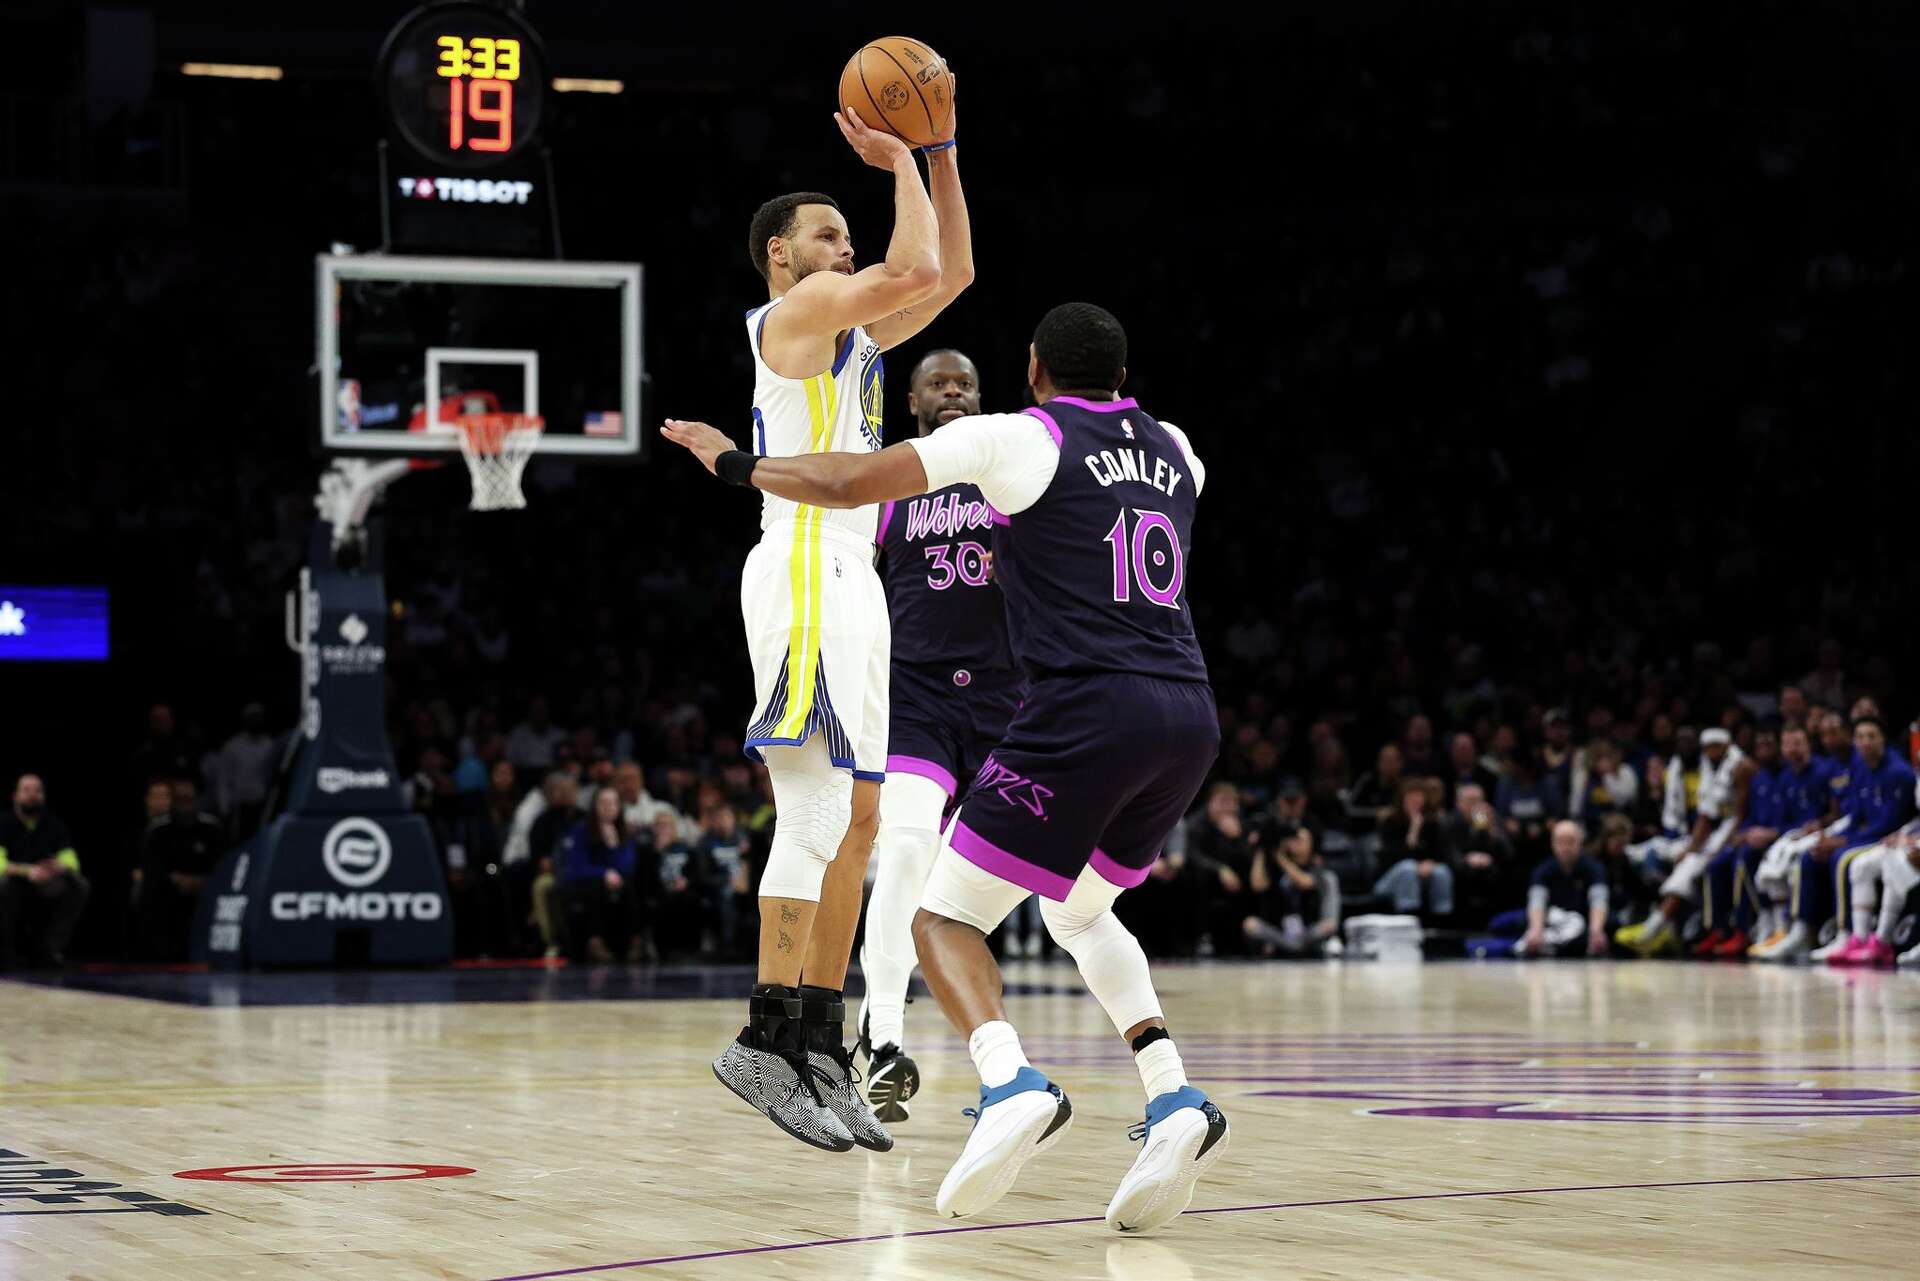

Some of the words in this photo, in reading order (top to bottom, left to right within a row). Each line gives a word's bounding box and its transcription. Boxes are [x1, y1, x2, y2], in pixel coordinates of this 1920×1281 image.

[437, 36, 521, 80] 3:33
[450, 77, 512, 152] 19
[434, 177, 533, 204] TISSOT
[1085, 448, 1183, 497] CONLEY
[905, 493, 993, 542] Wolves
[924, 541, 989, 590] 30
[1103, 507, 1183, 610] 10
[271, 892, 442, 920] CFMOTO
